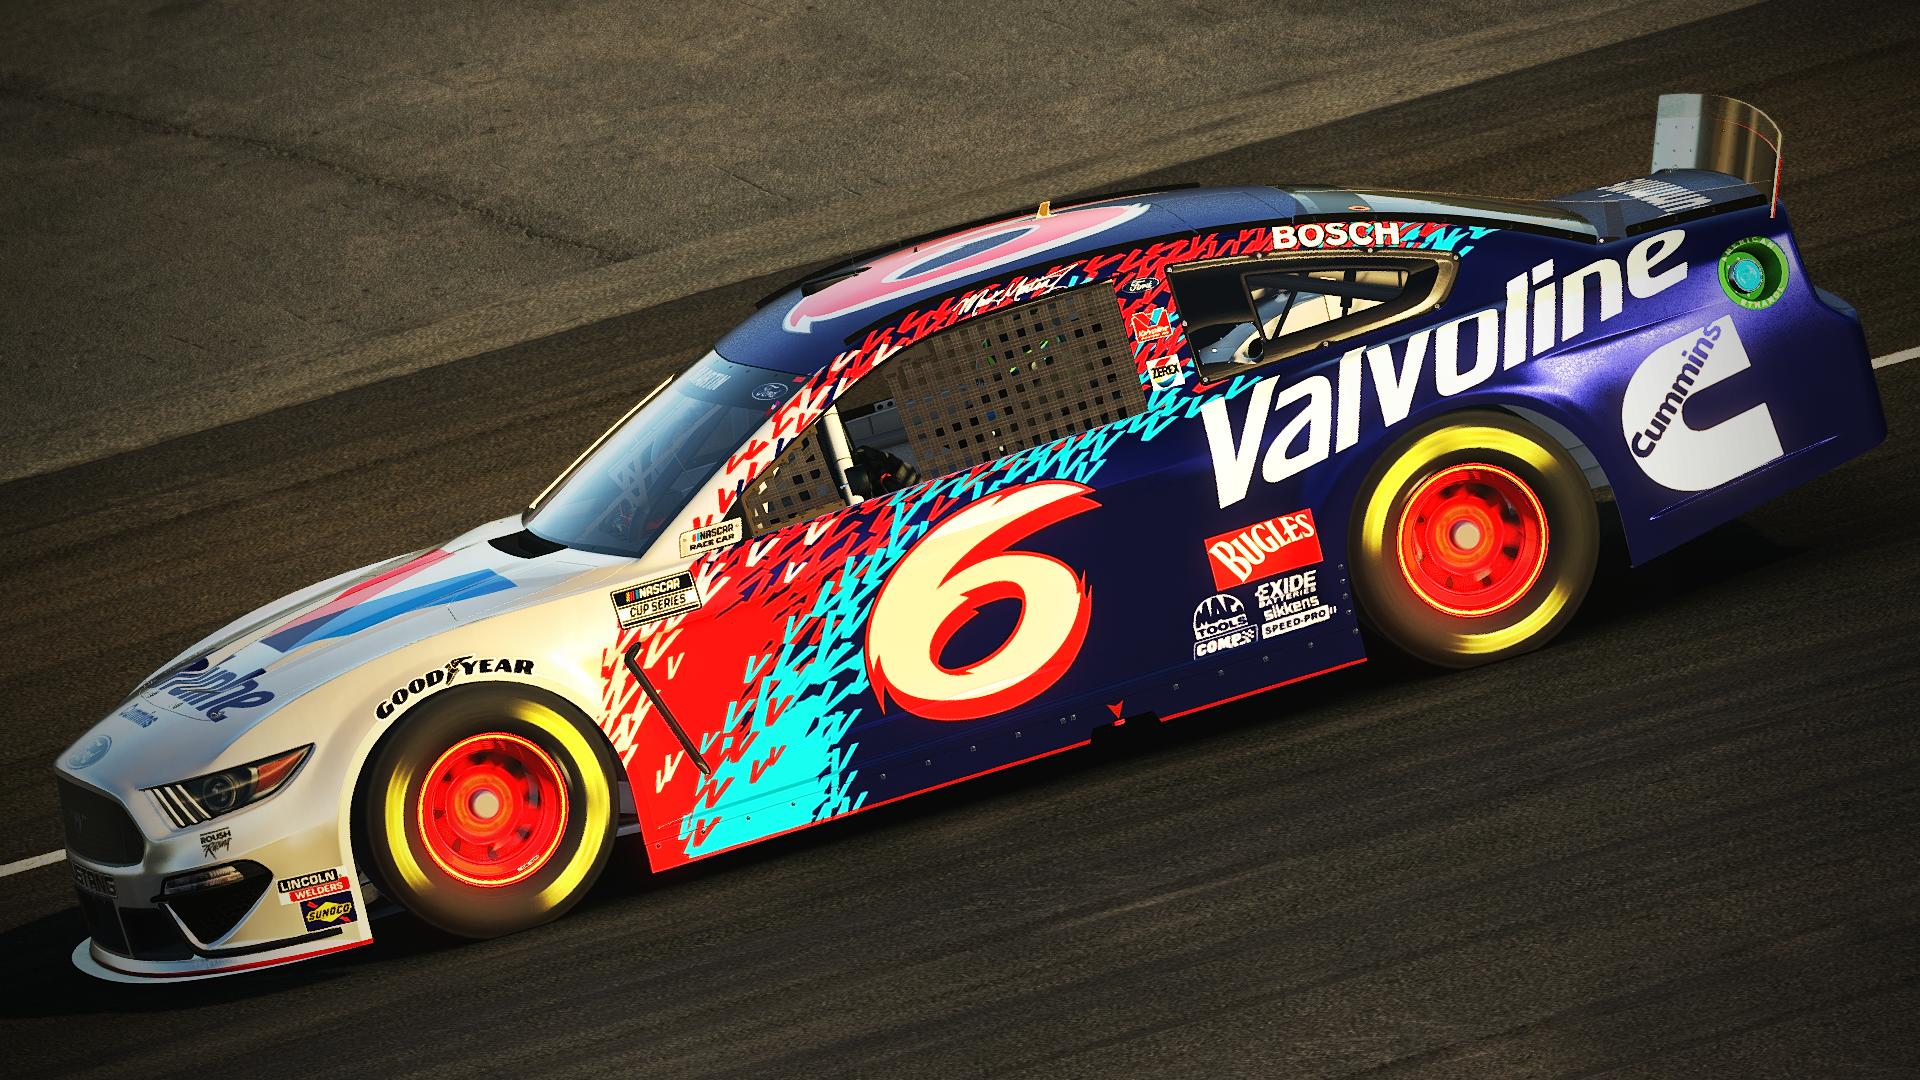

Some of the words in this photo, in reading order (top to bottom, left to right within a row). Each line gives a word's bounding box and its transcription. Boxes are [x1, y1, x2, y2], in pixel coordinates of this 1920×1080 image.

[1271, 222, 1400, 250] BOSCH
[1129, 280, 1152, 291] Ford
[1151, 364, 1179, 379] ZEREX
[1200, 229, 1689, 509] Valvoline
[1631, 325, 1722, 458] Cummins
[689, 538, 714, 551] RACE
[716, 533, 735, 545] CAR
[699, 524, 734, 541] NASCAR
[1209, 514, 1314, 583] BUGLES
[638, 578, 681, 601] NASCAR
[1255, 570, 1316, 600] EXIDE
[630, 601, 649, 618] CUP
[651, 594, 687, 613] SERIES
[864, 479, 1102, 721] 6
[1264, 596, 1319, 621] sikkens
[1197, 616, 1247, 637] TOOLS
[1265, 610, 1326, 635] SPEED-PRO
[200, 830, 231, 845] ROUSH
[279, 870, 335, 892] LINCOLN
[295, 881, 344, 900] WELDERS
[309, 903, 350, 921] SUNOCO
